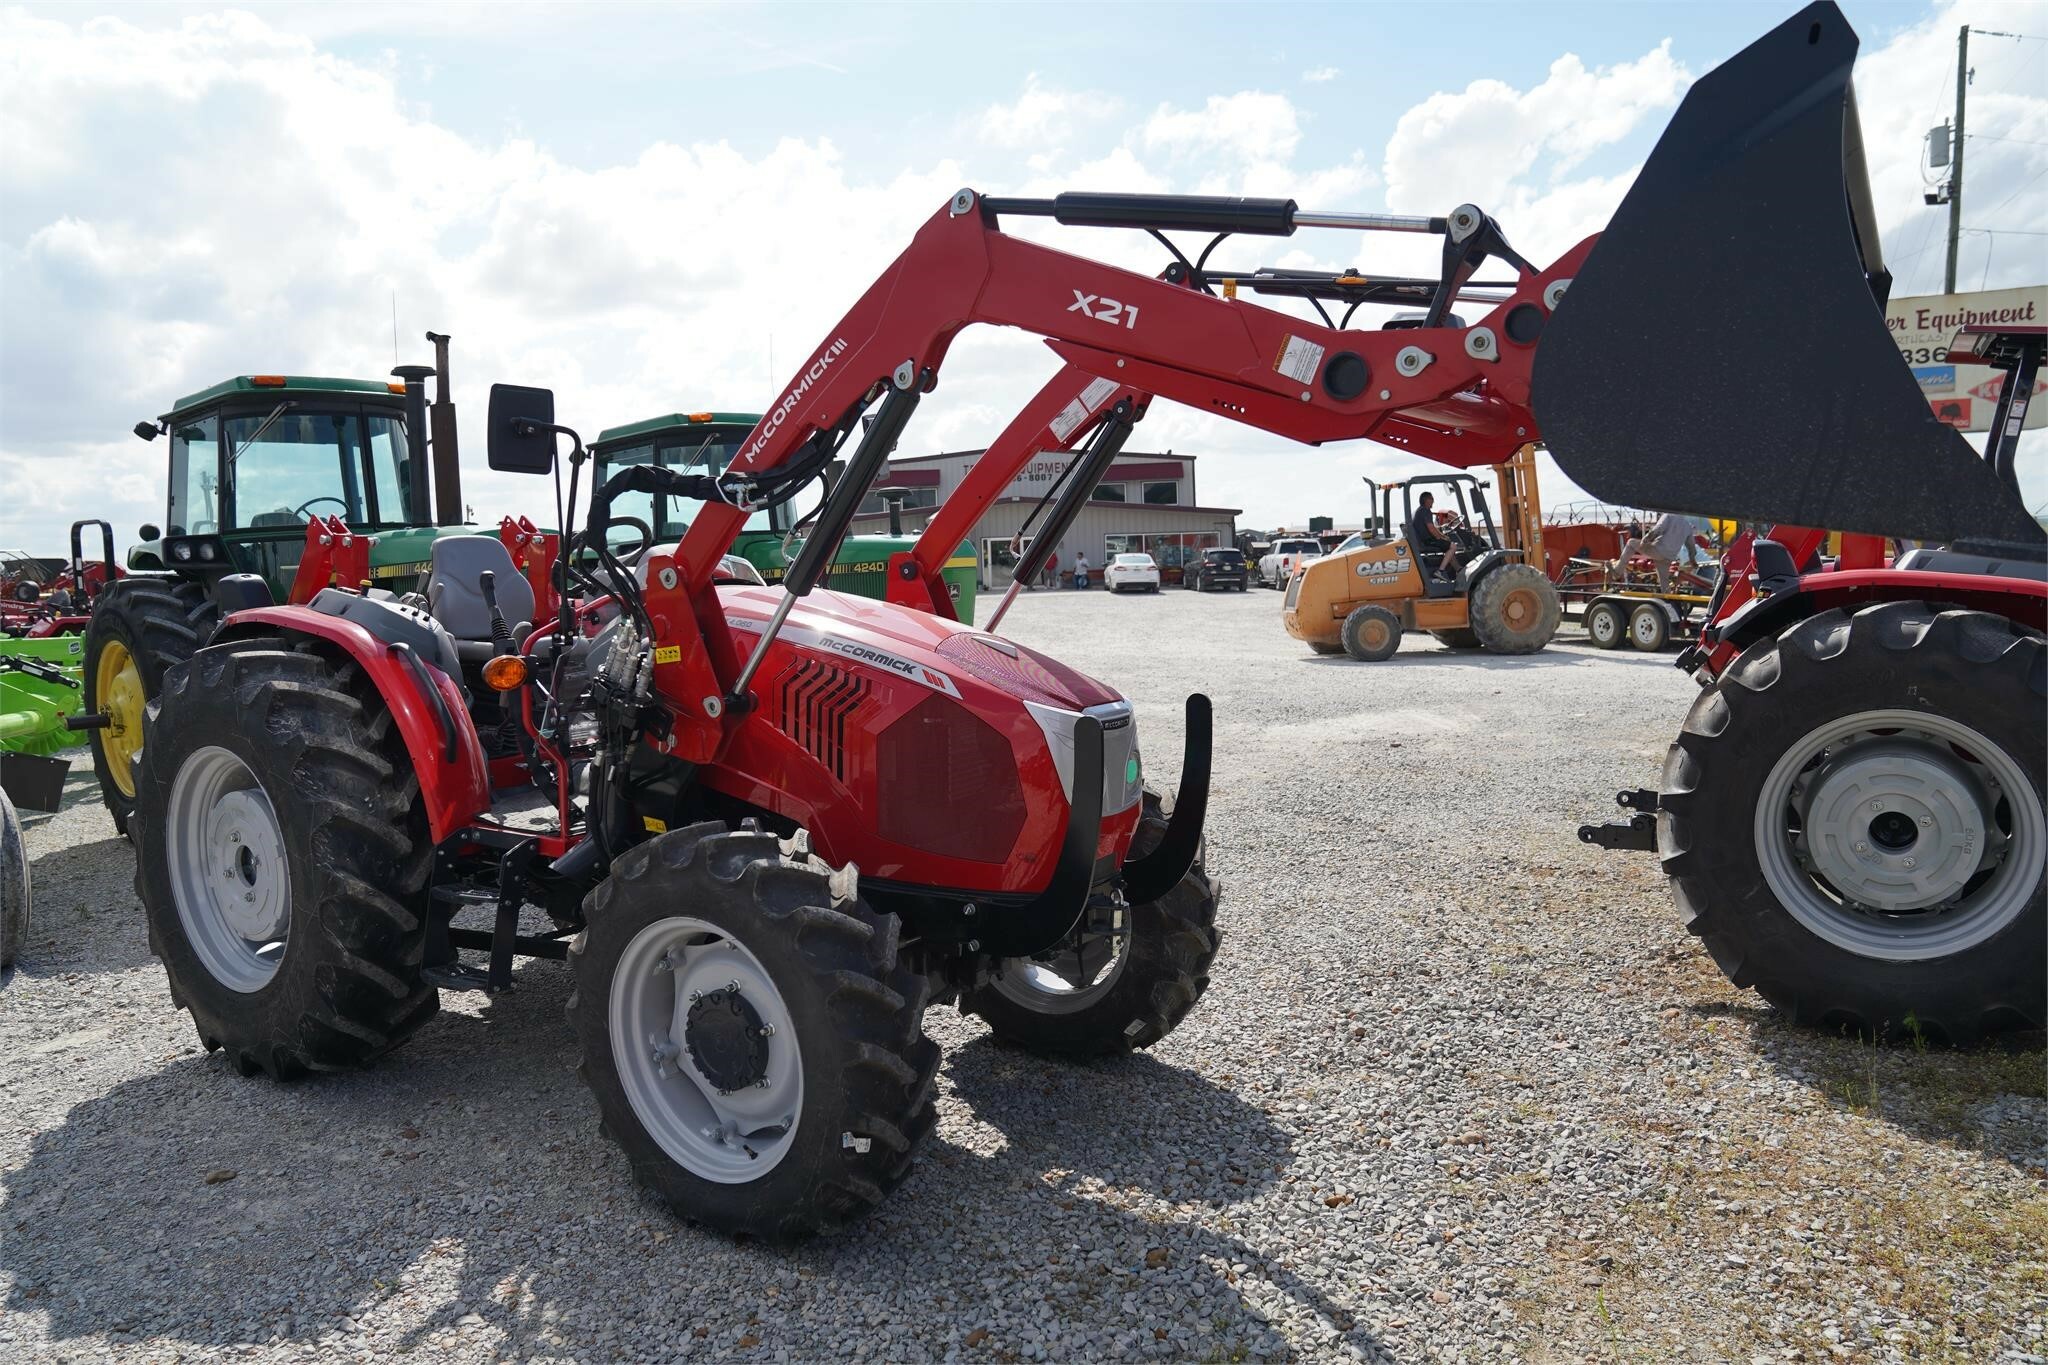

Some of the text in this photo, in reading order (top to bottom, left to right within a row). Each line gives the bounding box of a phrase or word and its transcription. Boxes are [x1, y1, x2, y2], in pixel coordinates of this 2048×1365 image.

[1066, 289, 1139, 329] X21
[1915, 301, 2036, 333] Equipment
[760, 569, 774, 579] OHN
[854, 562, 884, 573] 4240
[1357, 558, 1410, 577] CASE
